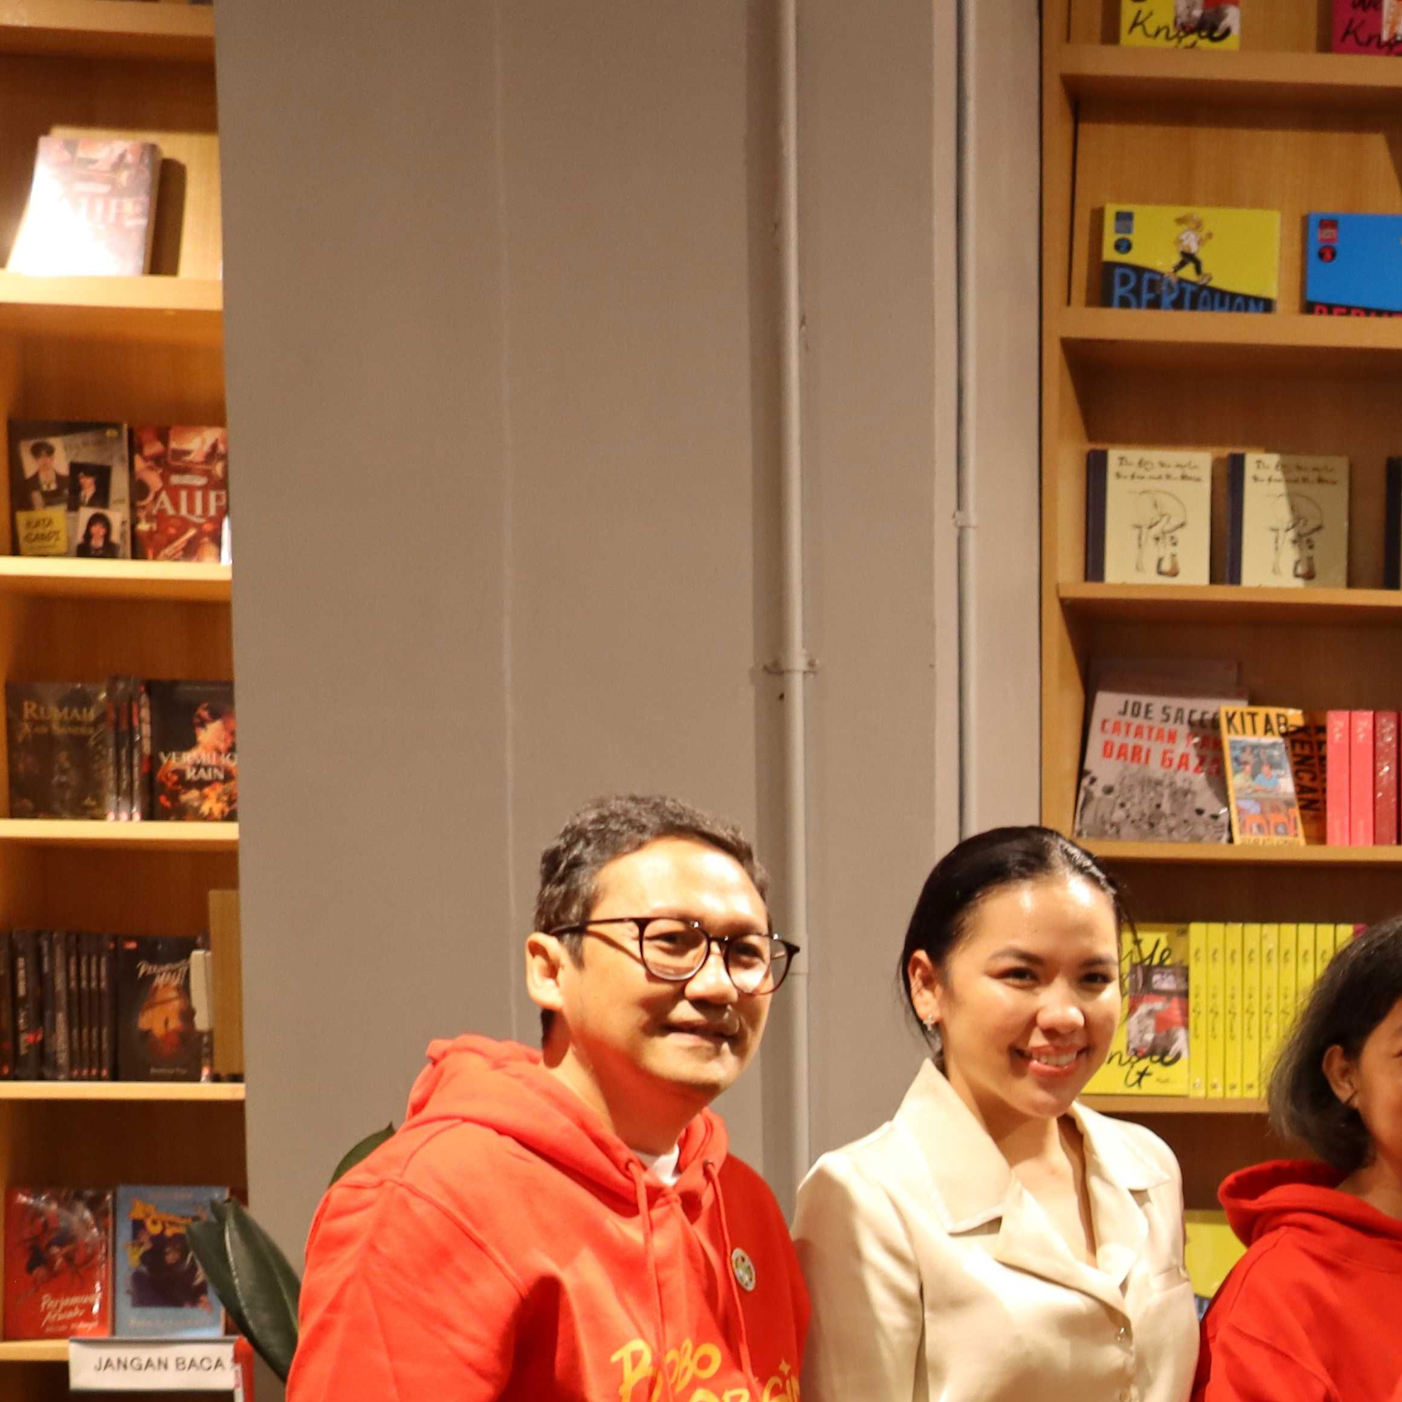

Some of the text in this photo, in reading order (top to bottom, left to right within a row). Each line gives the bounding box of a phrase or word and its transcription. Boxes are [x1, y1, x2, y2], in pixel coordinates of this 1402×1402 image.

[1118, 699, 1153, 720] JOE
[1100, 718, 1178, 745] CATATAN
[1225, 710, 1290, 736] KITAB
[159, 750, 238, 766] VERMILIO
[1102, 740, 1151, 766] DARI
[184, 767, 225, 781] RAIN
[1107, 1050, 1183, 1068] now
[94, 1356, 224, 1372] JANGAN BACA
